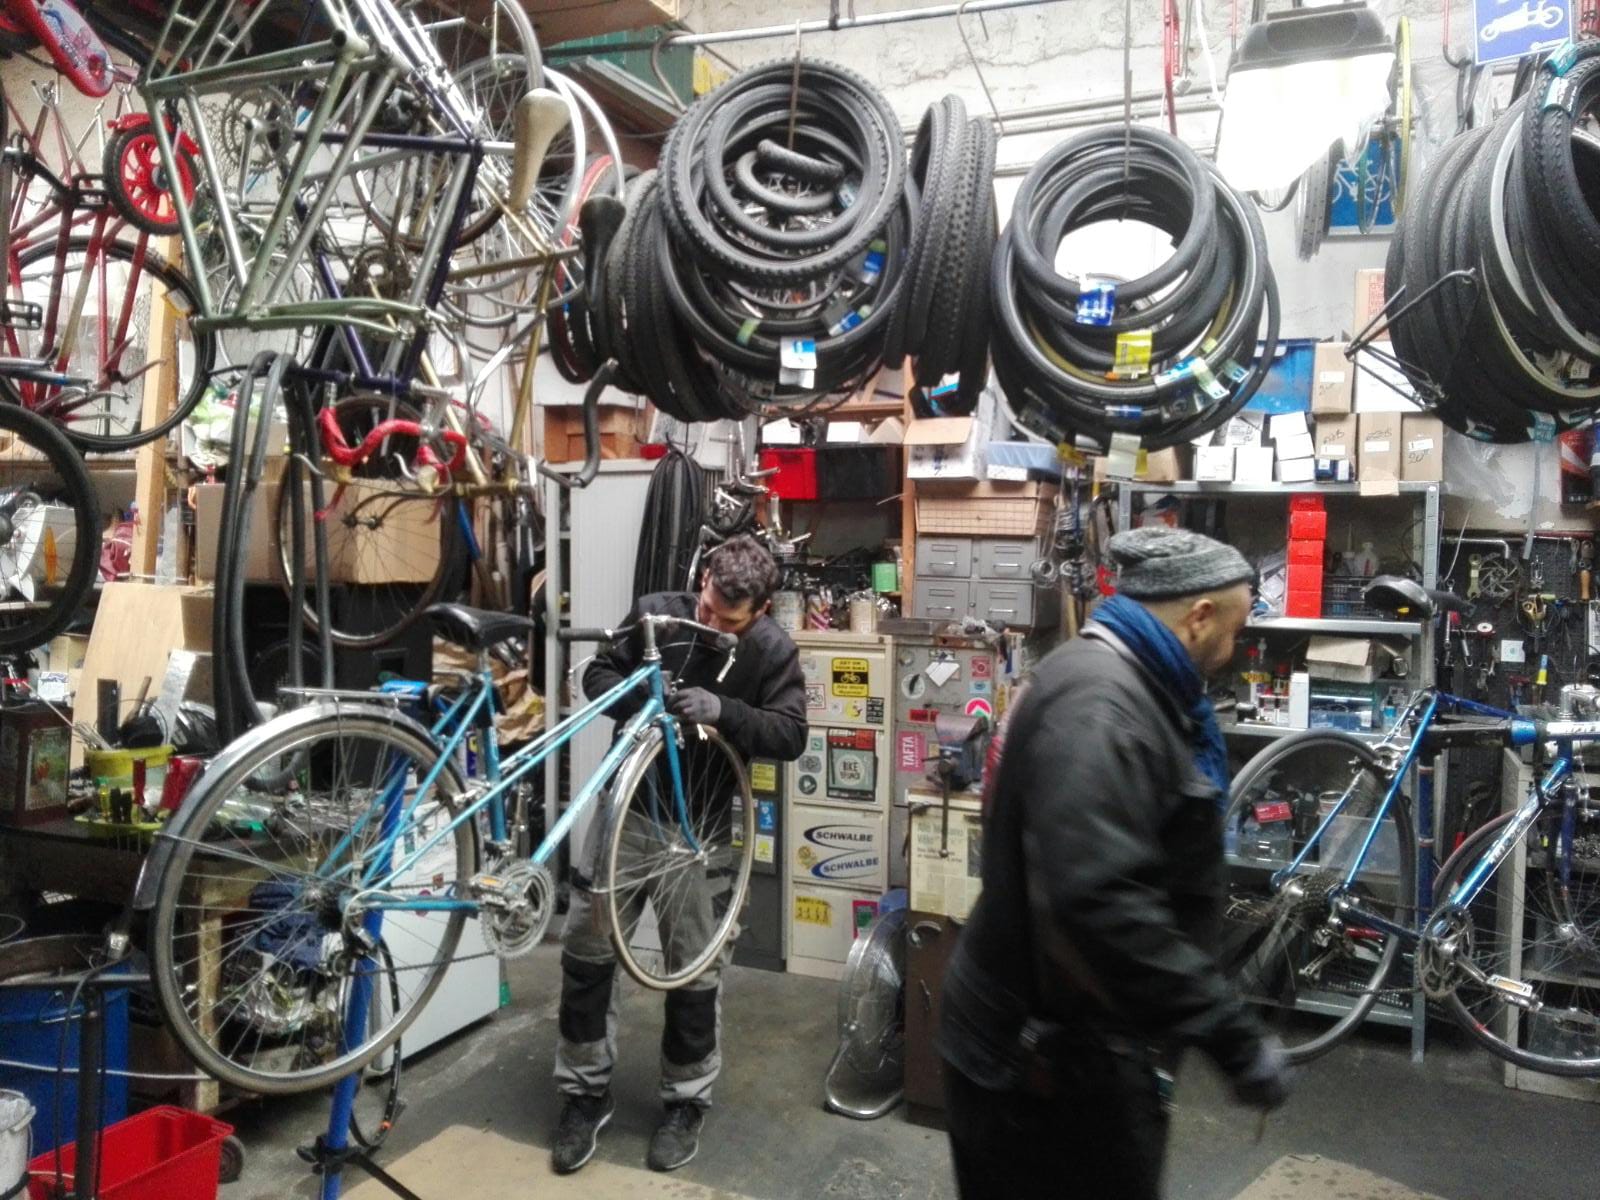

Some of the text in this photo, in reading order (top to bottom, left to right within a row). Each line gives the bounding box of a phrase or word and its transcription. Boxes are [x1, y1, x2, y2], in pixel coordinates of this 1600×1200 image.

[902, 736, 915, 767] TAFTA
[816, 831, 873, 842] SCHWALBE
[823, 857, 879, 872] SCHWALBE
